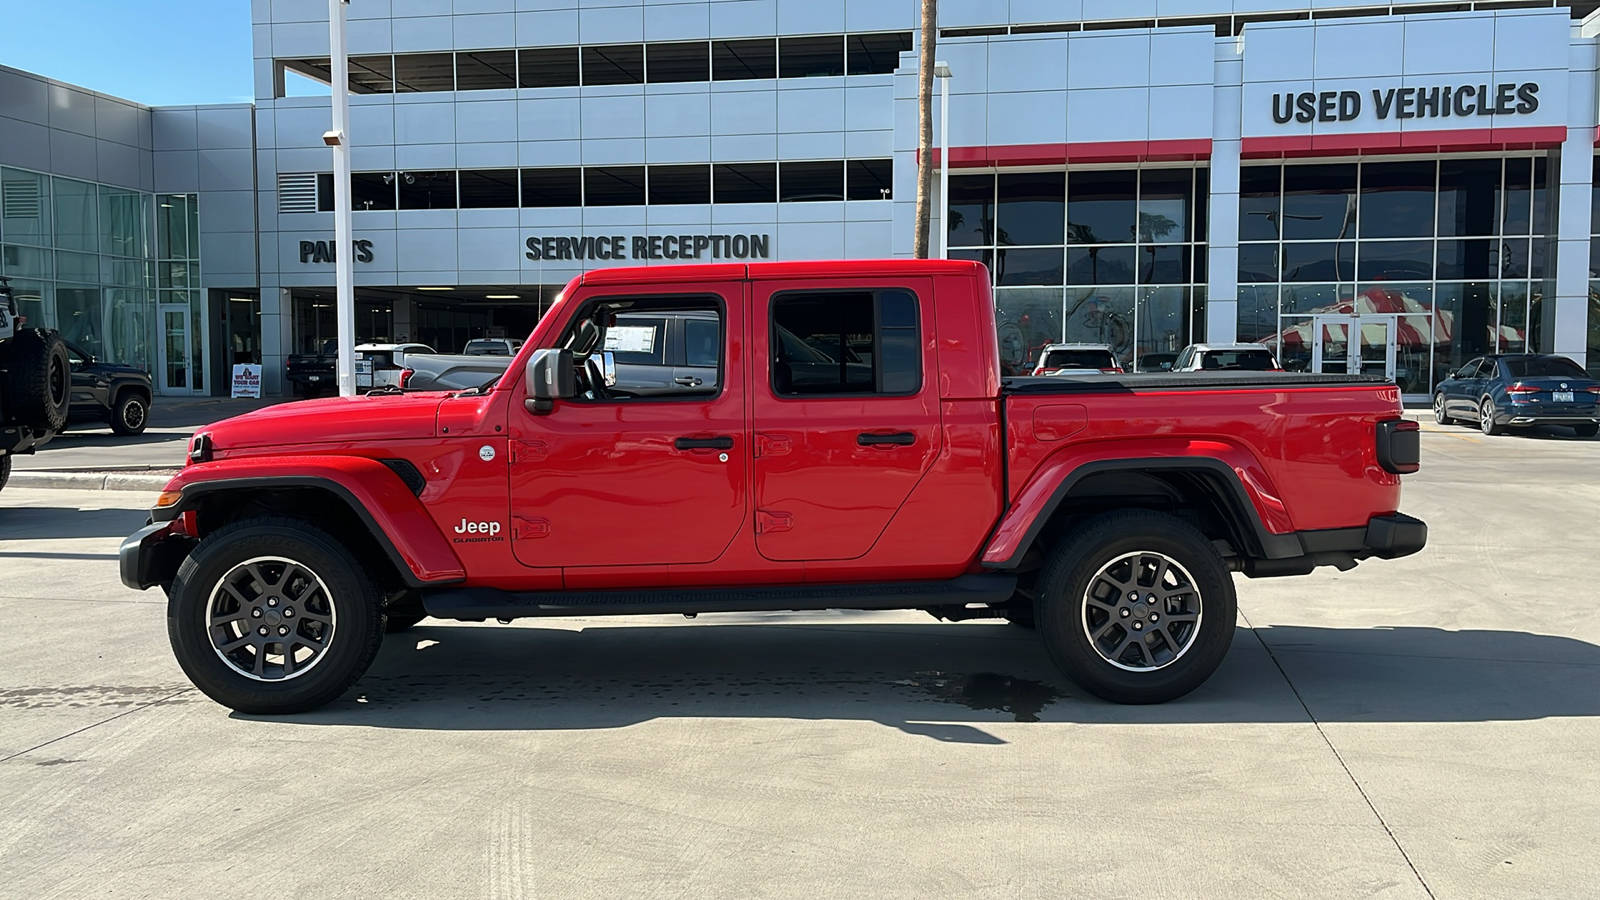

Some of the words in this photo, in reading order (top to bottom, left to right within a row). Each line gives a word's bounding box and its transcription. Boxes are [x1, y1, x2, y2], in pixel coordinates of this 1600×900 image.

[1272, 90, 1361, 123] USED
[1372, 82, 1539, 119] VEHICLES
[526, 236, 626, 260] SERVICE
[631, 234, 768, 259] RECEPTION
[454, 518, 501, 536] Jeep
